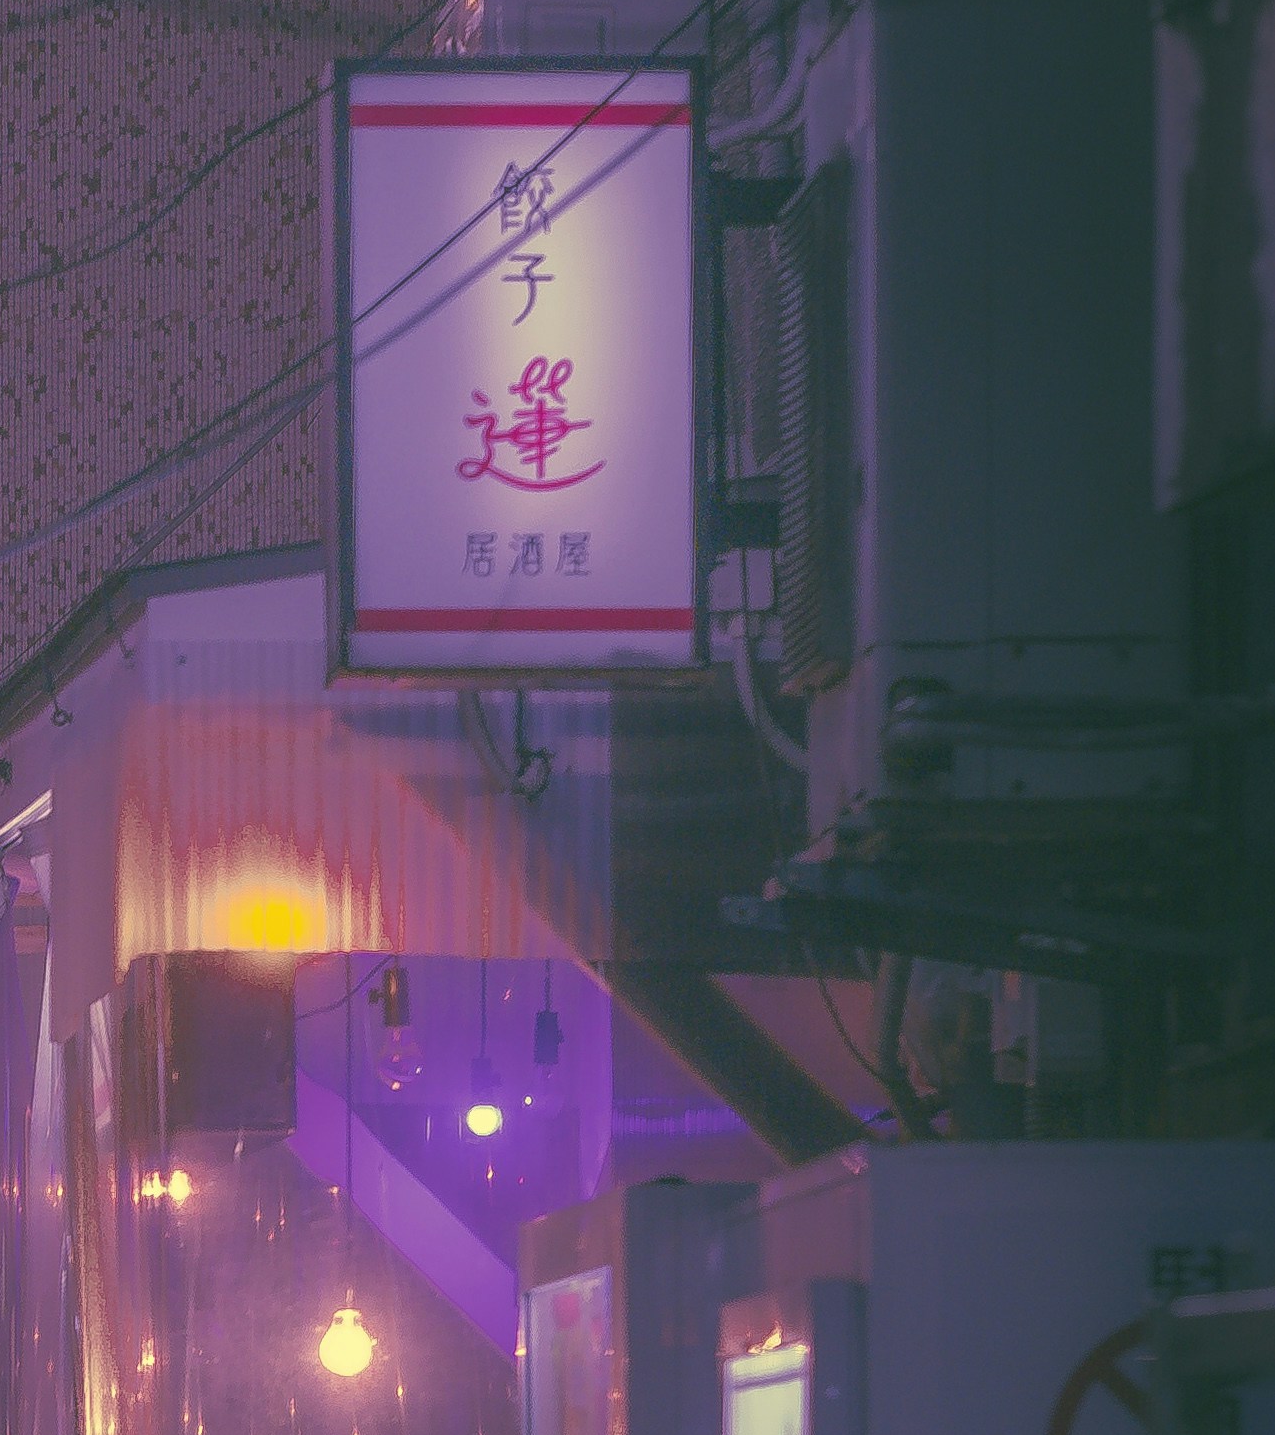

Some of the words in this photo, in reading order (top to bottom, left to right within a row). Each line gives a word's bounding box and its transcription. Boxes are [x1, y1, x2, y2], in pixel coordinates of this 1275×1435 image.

[491, 162, 555, 327] 餃子
[461, 532, 593, 577] 居酒屋
